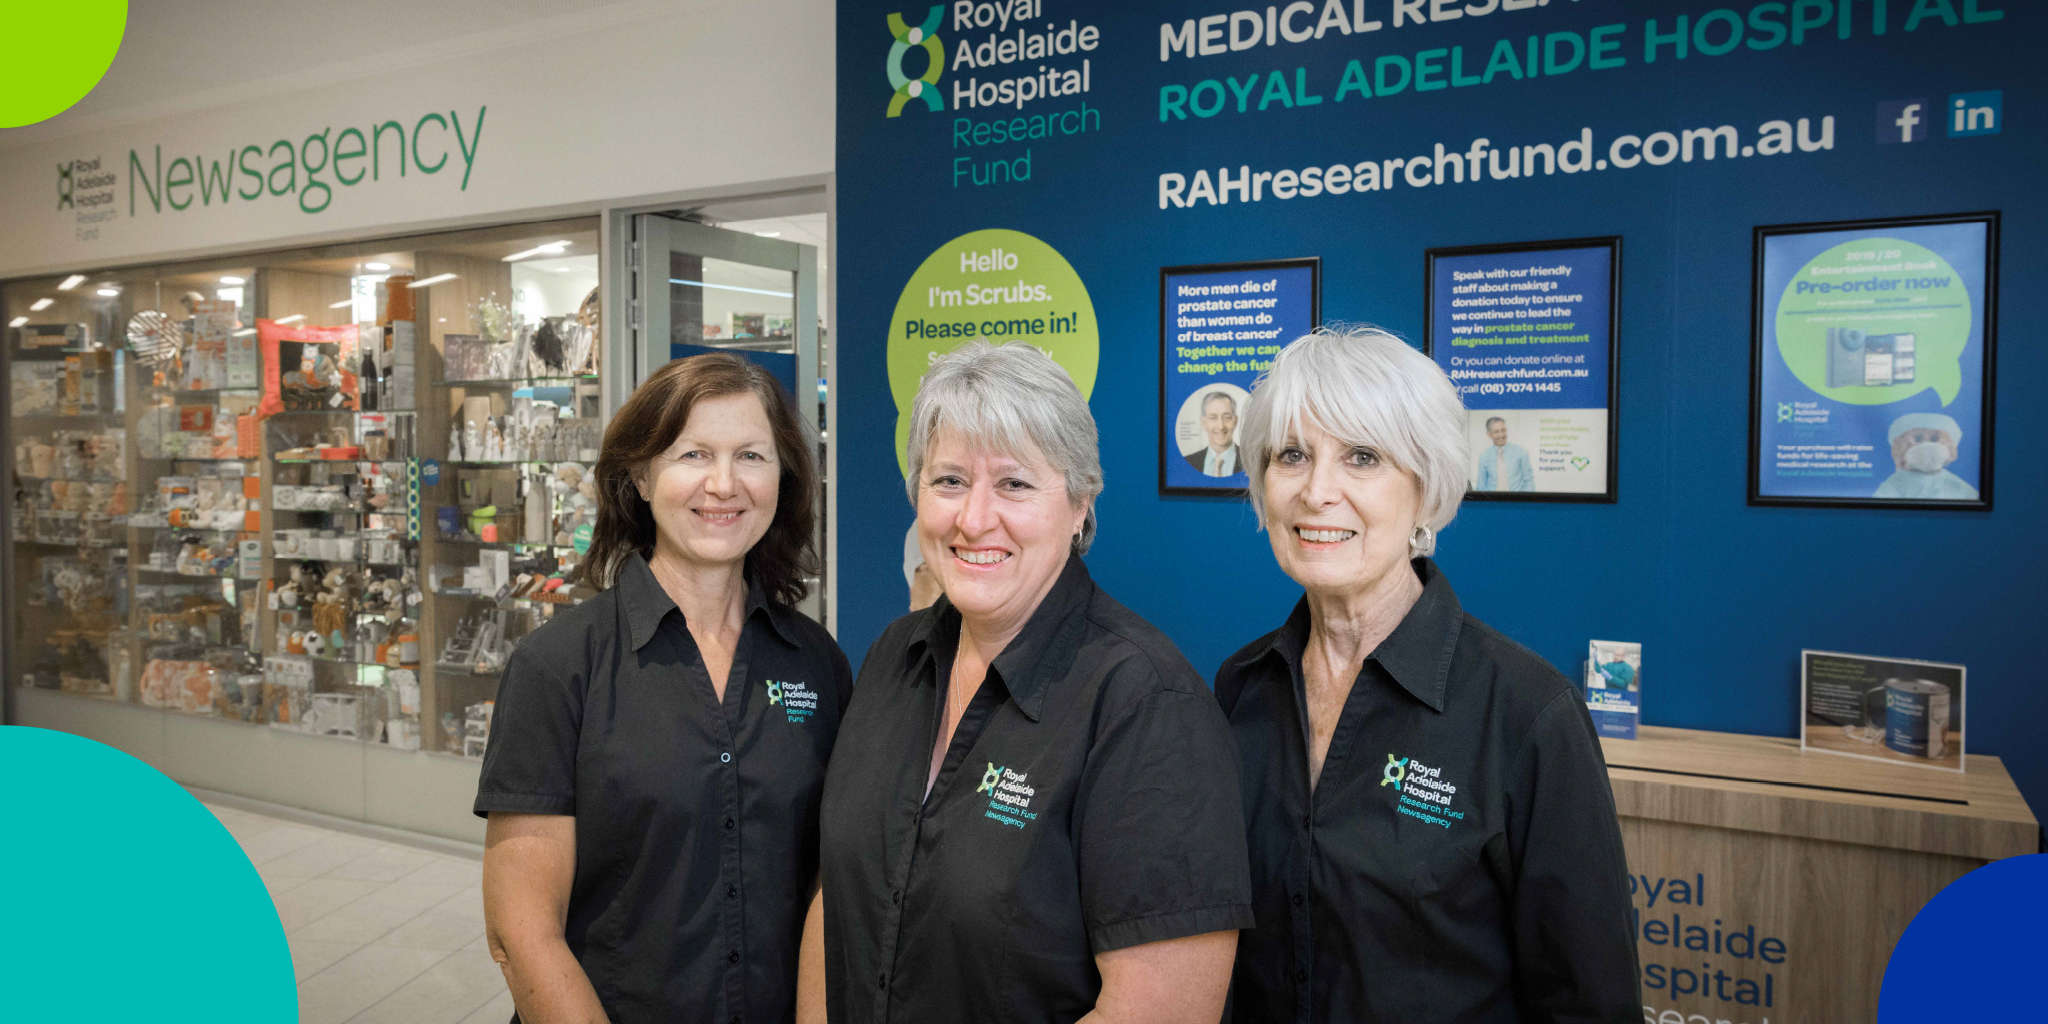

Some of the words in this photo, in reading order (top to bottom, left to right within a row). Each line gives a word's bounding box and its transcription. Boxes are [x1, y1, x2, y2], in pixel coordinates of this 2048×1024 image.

[953, 0, 1042, 32] Royal
[1160, 0, 1382, 62] MEDICAL
[952, 20, 1100, 71] Adelaide
[1159, 67, 1323, 123] ROYAL
[1334, 24, 1627, 103] ADELAIDE
[1643, 0, 2004, 63] HOSPITAL
[953, 59, 1090, 110] Hospital
[953, 101, 1100, 148] Research
[128, 105, 488, 216] Newsagency
[953, 148, 1031, 188] Fund
[1158, 116, 1835, 210] RAHresearchfund.com.au
[960, 248, 1018, 273] Hello
[1811, 263, 1903, 276] Entertainment
[1904, 261, 1937, 271] Book
[1453, 269, 1485, 282] Speak
[1486, 268, 1508, 279] with
[1510, 269, 1529, 278] our
[1529, 265, 1572, 277] friendly
[929, 286, 962, 308] I'm
[966, 280, 1052, 306] Scrubs.
[1178, 285, 1209, 297] More
[1211, 284, 1239, 295] men
[1240, 280, 1261, 294] die
[1262, 279, 1277, 292] of
[1453, 283, 1477, 294] staff
[1478, 282, 1509, 293] about
[1510, 280, 1549, 292] making
[1550, 282, 1557, 290] a
[1796, 277, 1902, 294] Pre-order
[1905, 276, 1952, 289] now
[1178, 299, 1232, 315] prostate
[1234, 298, 1278, 309] cancer
[1452, 297, 1498, 307] donation
[1500, 295, 1530, 307] today
[1532, 295, 1543, 304] to
[1545, 294, 1582, 303] ensure
[1177, 316, 1206, 328] than
[1208, 315, 1254, 326] women
[1255, 312, 1273, 324] do
[1452, 313, 1467, 321] we
[1468, 309, 1514, 320] continue
[1516, 310, 1527, 319] to
[1528, 308, 1551, 318] lead
[1553, 307, 1571, 317] the
[905, 319, 976, 340] Please
[981, 318, 1045, 336] come
[1050, 311, 1078, 333] in!
[1452, 325, 1472, 334] way
[1474, 324, 1484, 333] in
[1485, 323, 1534, 334] prostate
[1536, 322, 1575, 331] cancer
[1177, 331, 1192, 342] of
[1193, 330, 1234, 341] breast
[1451, 336, 1503, 348] diagnosis
[1505, 335, 1527, 345] and
[1529, 334, 1590, 344] treatment
[1176, 345, 1234, 360] Together
[1236, 346, 1255, 356] we
[1257, 345, 1281, 355] can
[1451, 357, 1464, 366] Or
[1465, 358, 1483, 367] you
[1484, 357, 1502, 366] can
[1504, 355, 1540, 365] donate
[1541, 354, 1573, 364] online
[1574, 354, 1585, 364] at
[1178, 361, 1224, 375] change
[1226, 360, 1248, 372] the
[1451, 368, 1589, 379] RAHresearchfund.com.au
[1462, 384, 1479, 393] call
[1480, 382, 1504, 395] (08)
[1505, 382, 1534, 393] 7074
[1535, 382, 1562, 392] 1445
[782, 681, 805, 691] Royal
[784, 690, 818, 700] Adelaide
[785, 699, 817, 709] Hospital
[1003, 768, 1027, 783] Royal
[1409, 760, 1441, 778] Royal
[998, 780, 1035, 796] Adelaide
[1406, 772, 1456, 794] Adelaide
[993, 790, 1030, 807] Hospital
[1403, 782, 1451, 805] Hospital
[989, 800, 1019, 815] Research
[1020, 810, 1037, 820] Fund
[1400, 795, 1441, 814] Research
[1443, 808, 1464, 819] Fund
[985, 810, 1026, 829] Newsagency
[1397, 805, 1451, 829] Newsagency
[1633, 908, 1787, 964] elaide
[1644, 962, 1773, 1008] spital
